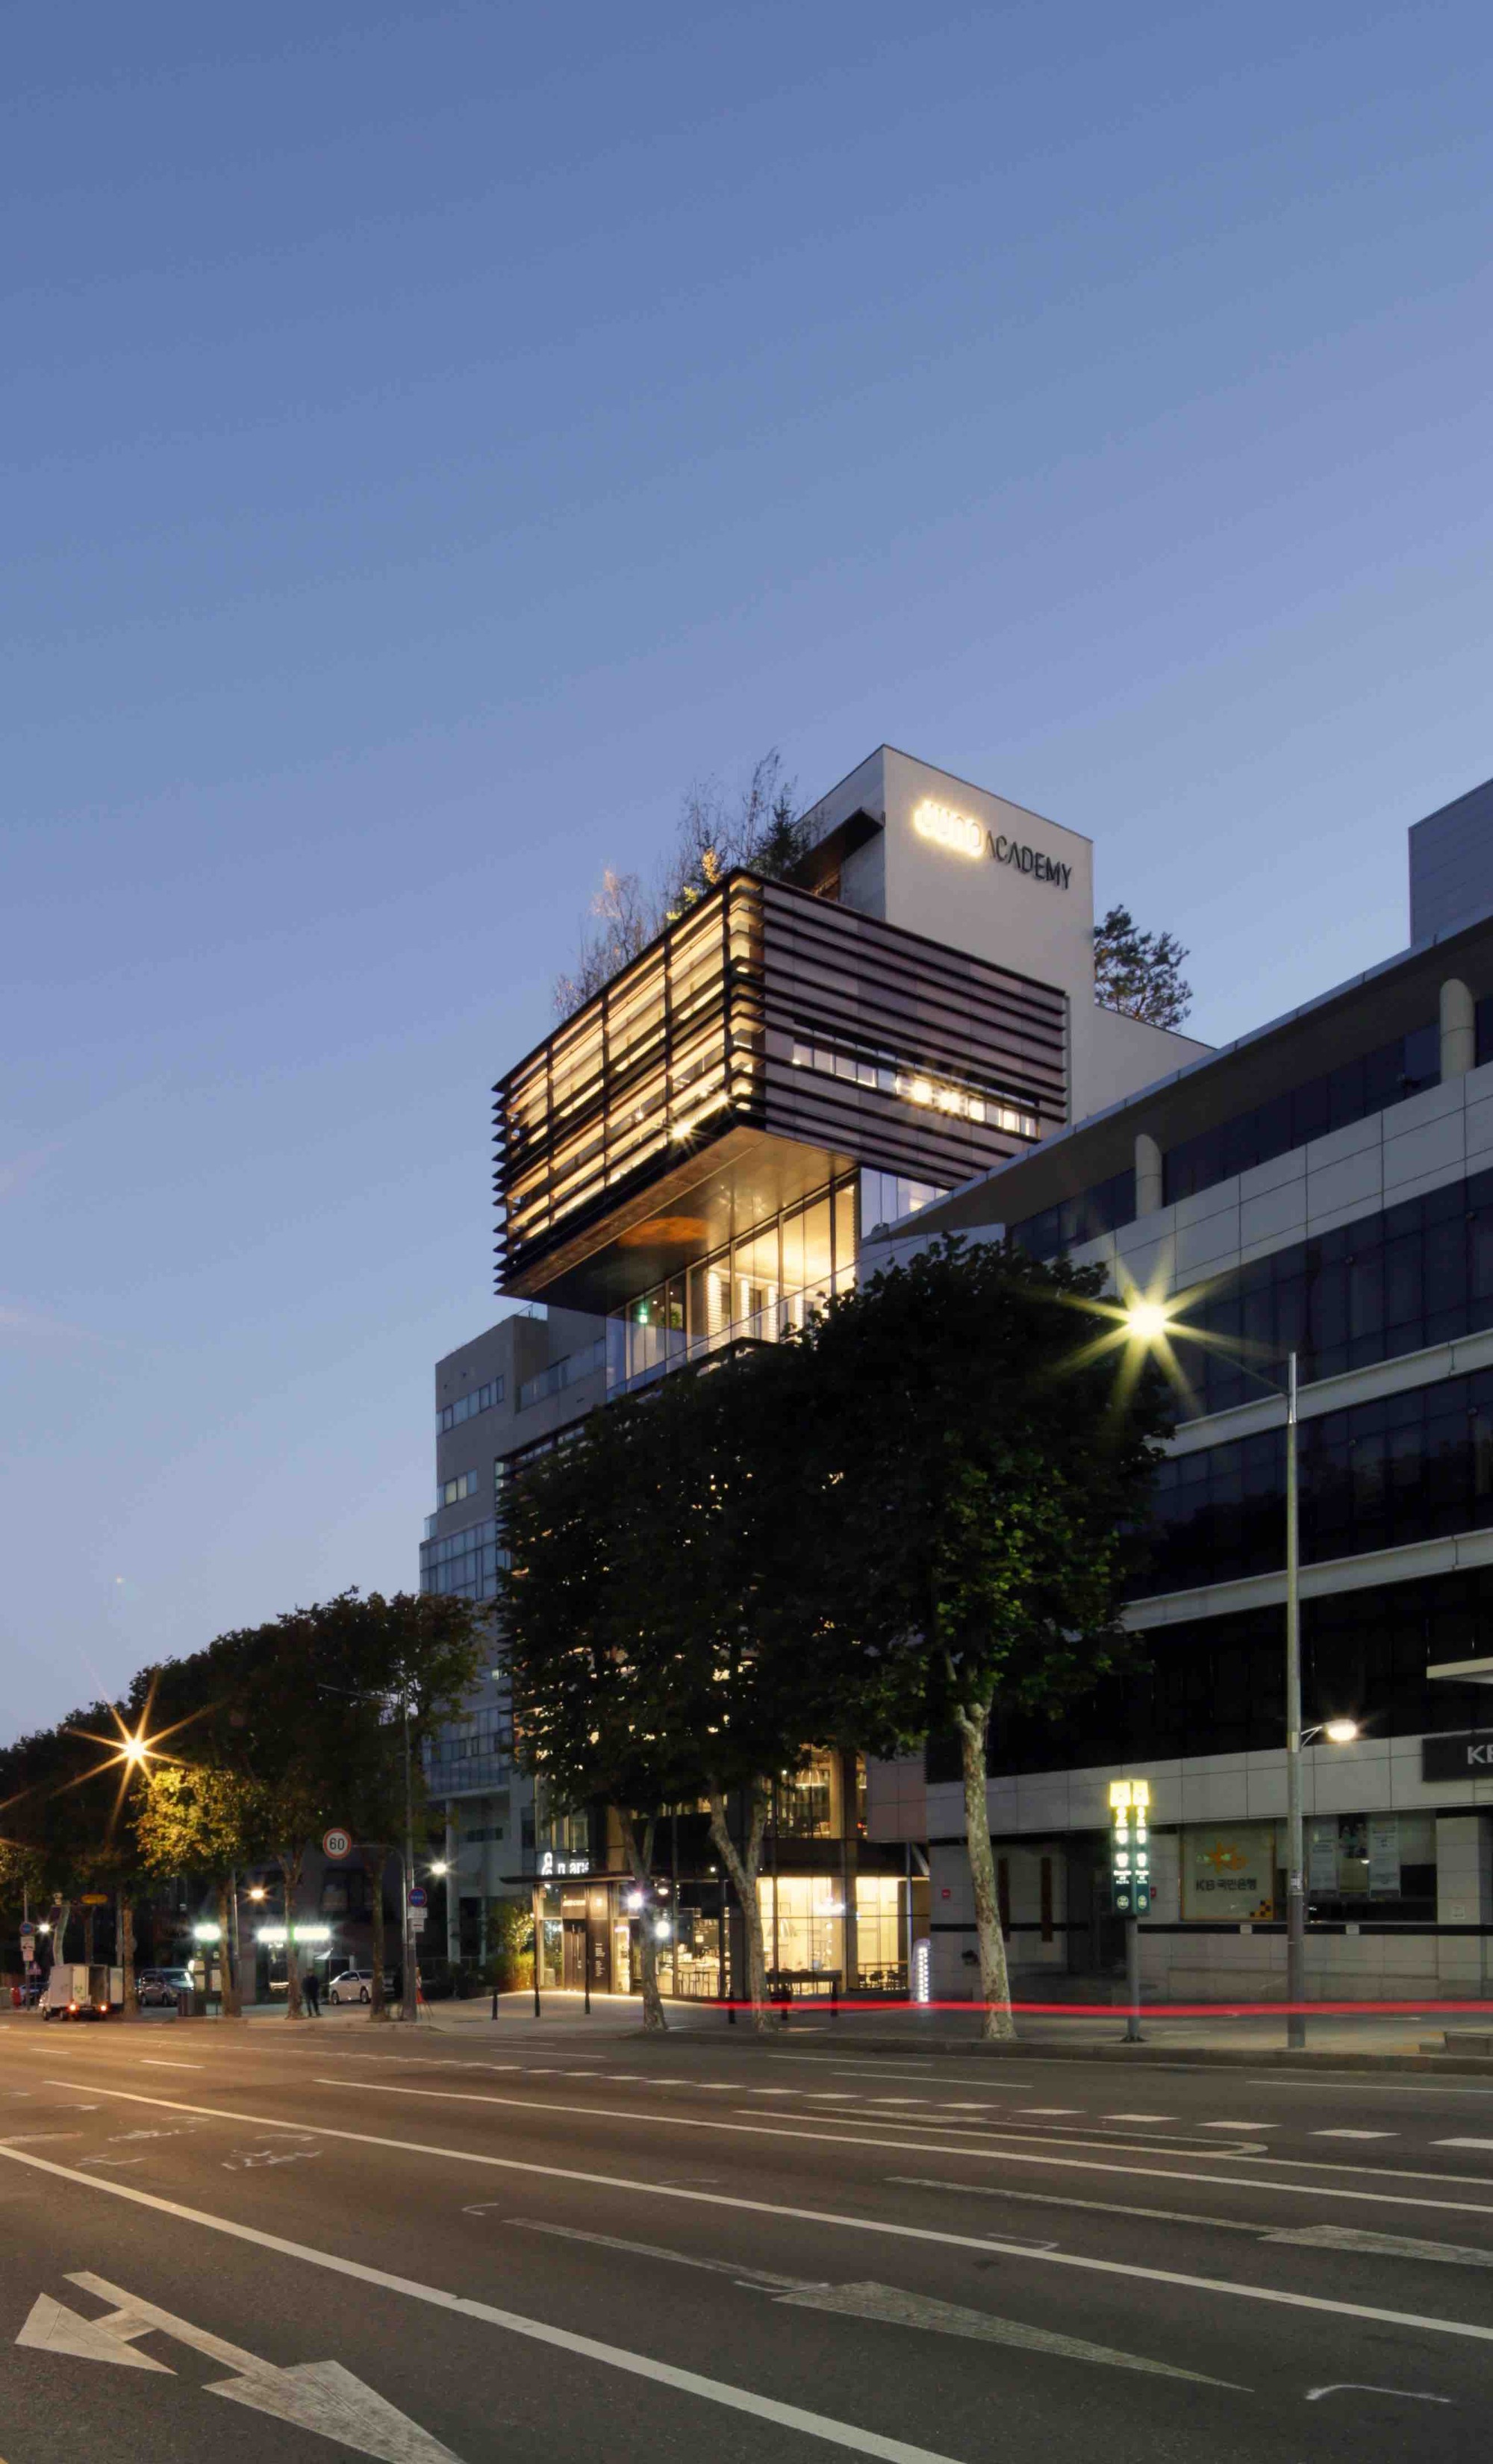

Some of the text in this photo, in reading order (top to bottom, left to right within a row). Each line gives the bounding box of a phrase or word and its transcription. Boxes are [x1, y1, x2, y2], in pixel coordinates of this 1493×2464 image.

[985, 829, 1072, 891] ACADEMY
[329, 1837, 345, 1850] 60
[1196, 1877, 1256, 1891] KB 국민은행
